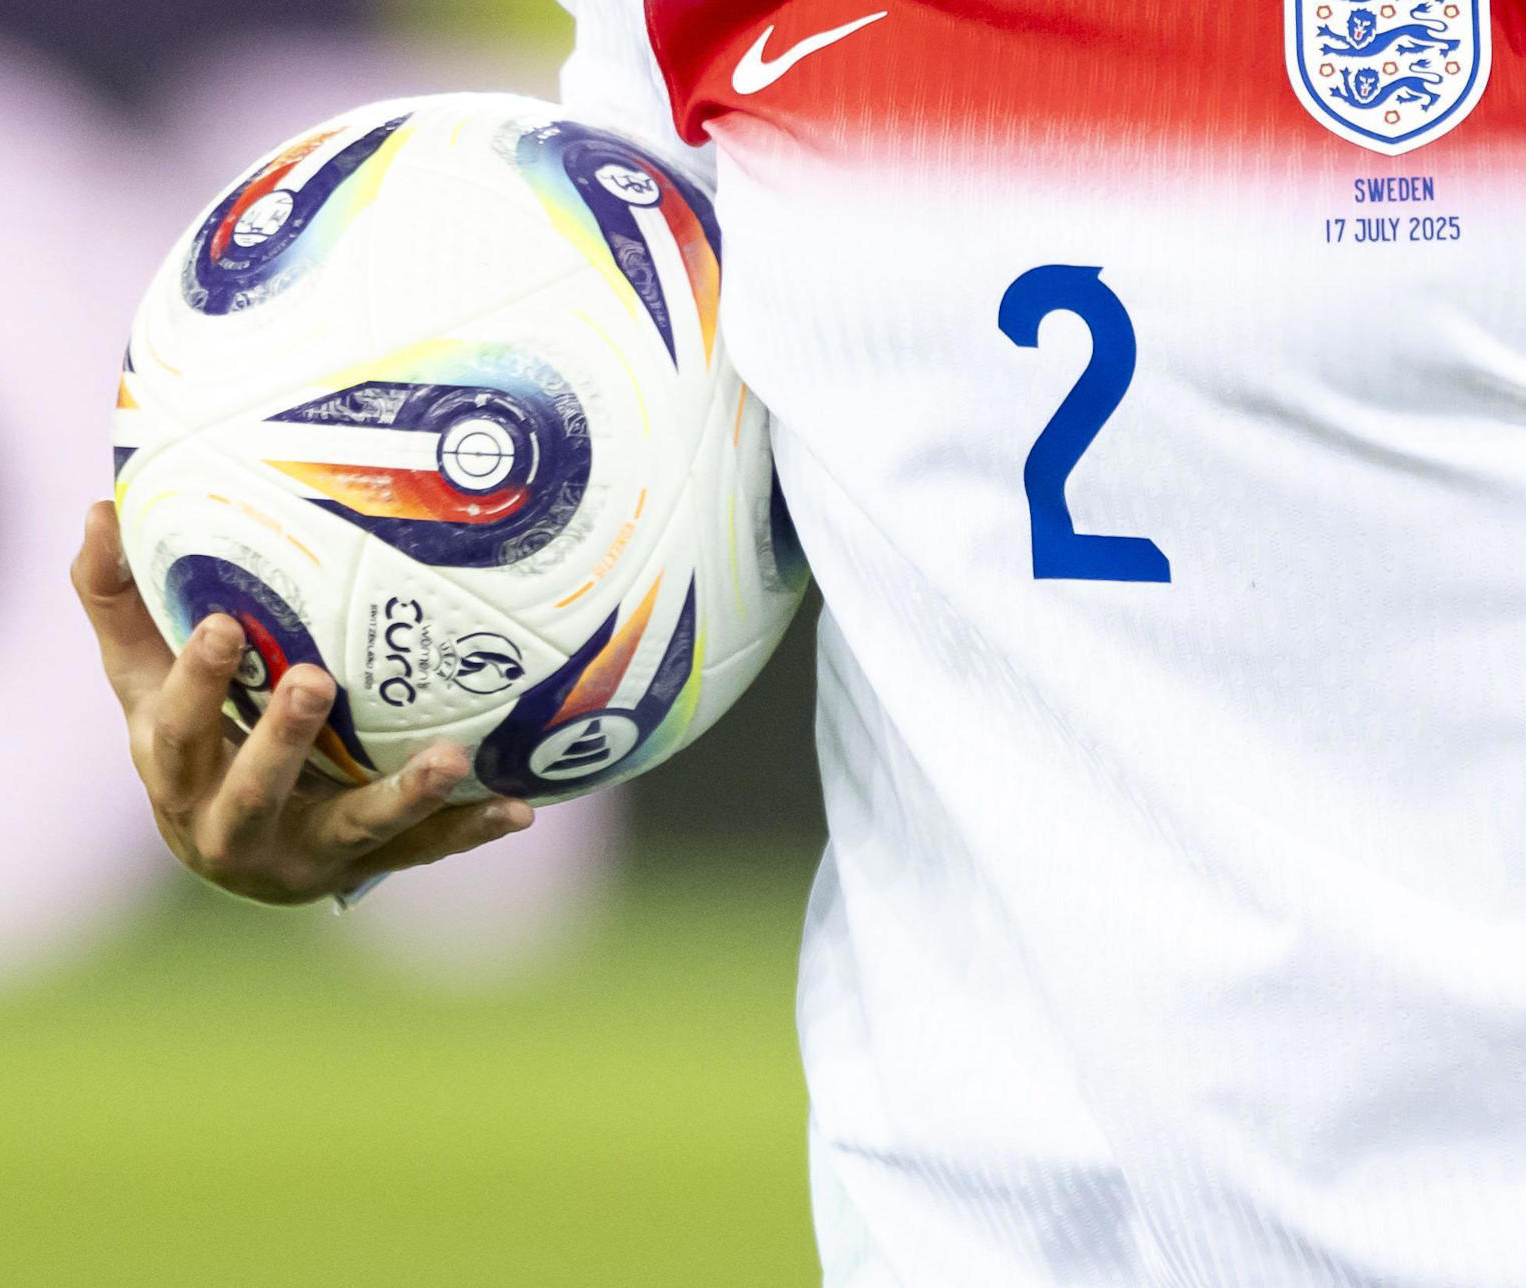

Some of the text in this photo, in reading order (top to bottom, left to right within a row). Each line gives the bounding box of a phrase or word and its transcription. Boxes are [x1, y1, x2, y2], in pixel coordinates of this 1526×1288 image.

[1354, 176, 1435, 203] SWEDEN
[1326, 215, 1461, 243] 17 JULY 2025
[997, 263, 1172, 584] 2
